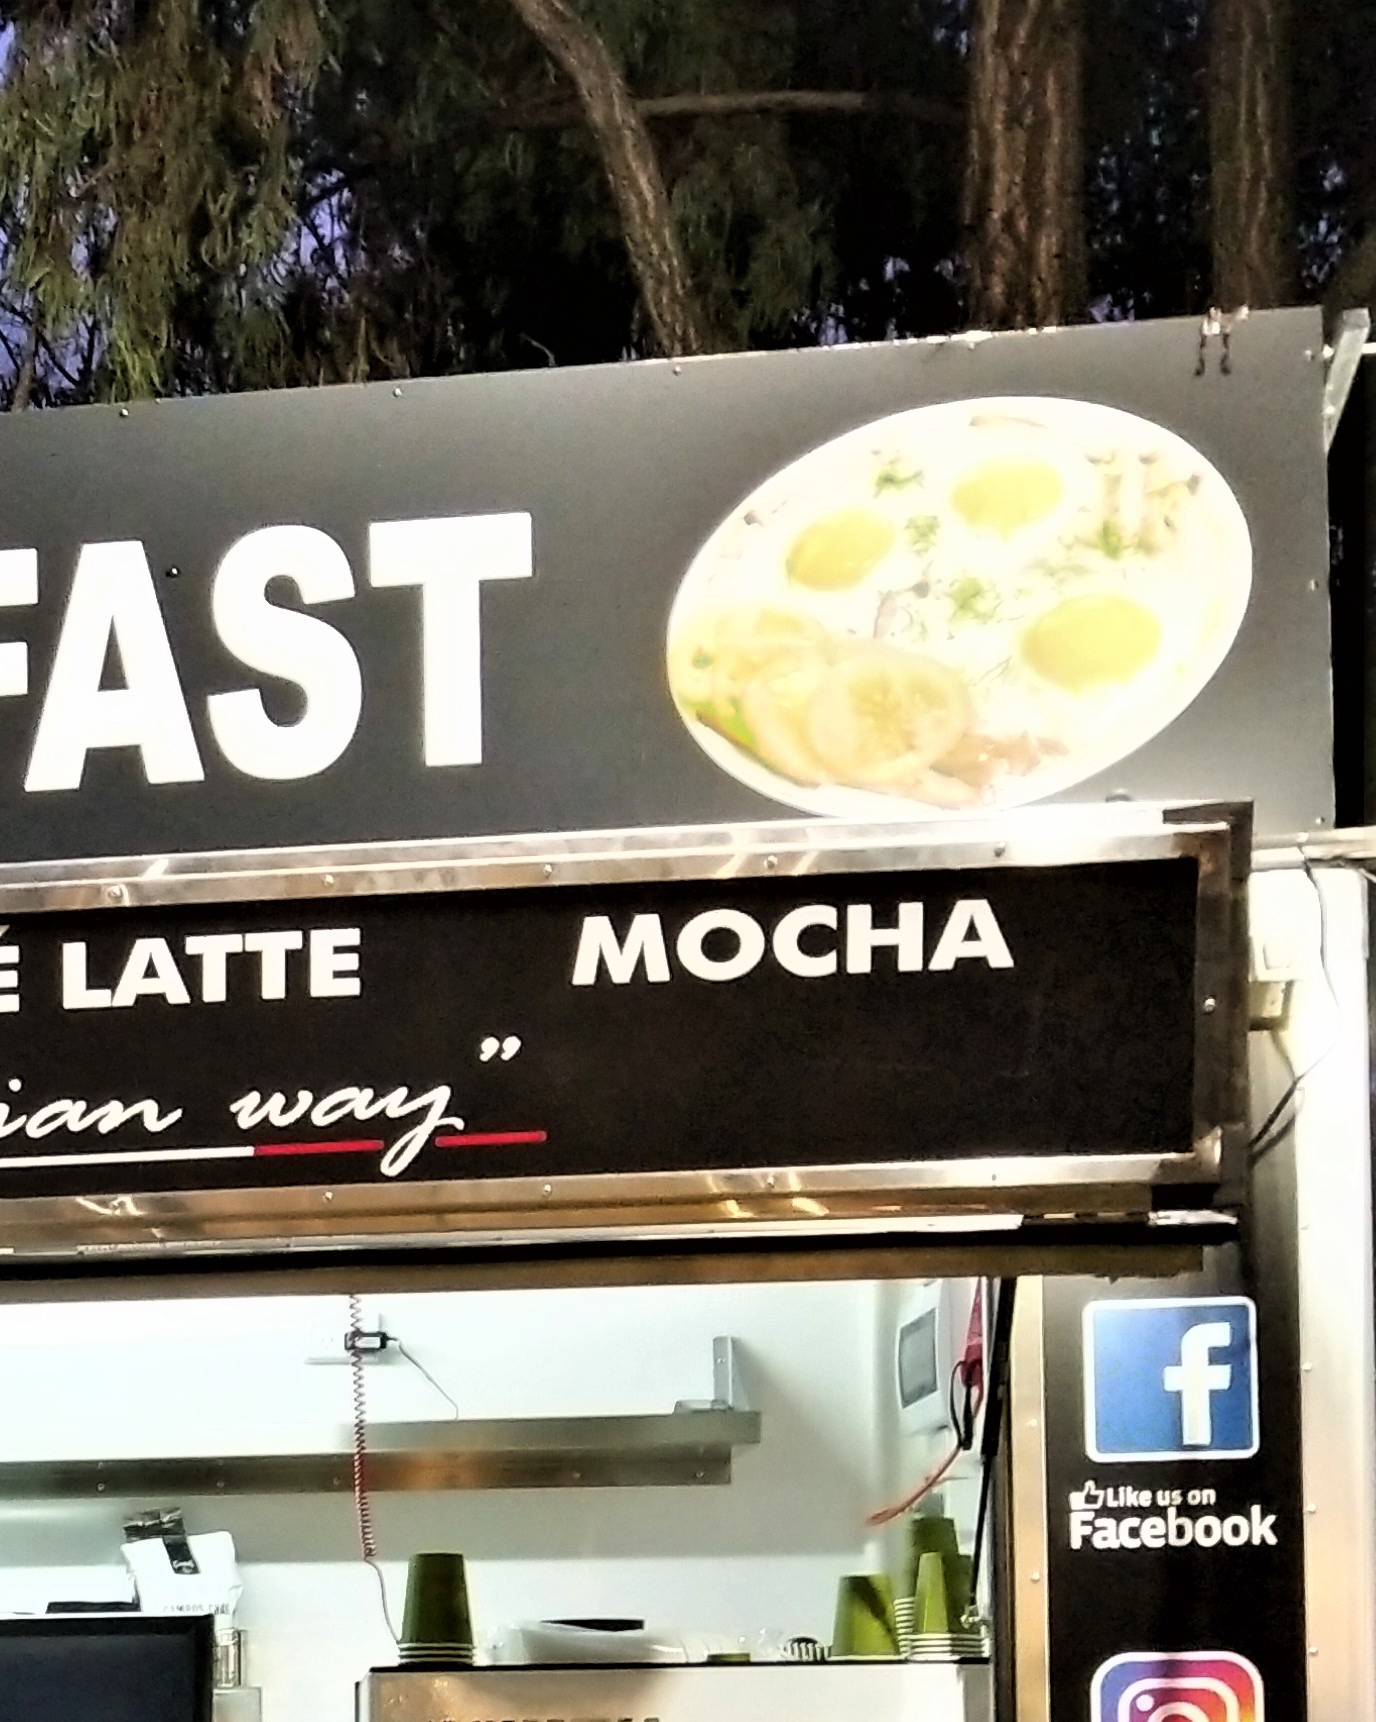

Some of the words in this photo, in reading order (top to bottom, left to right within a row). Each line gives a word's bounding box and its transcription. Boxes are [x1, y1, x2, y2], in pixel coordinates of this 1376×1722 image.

[62, 928, 362, 1009] LATTE
[572, 899, 1015, 986] MOCHA
[1106, 1485, 1152, 1508] Like
[1157, 1489, 1183, 1507] us
[1186, 1488, 1217, 1506] on
[1068, 1504, 1278, 1550] Facebook
